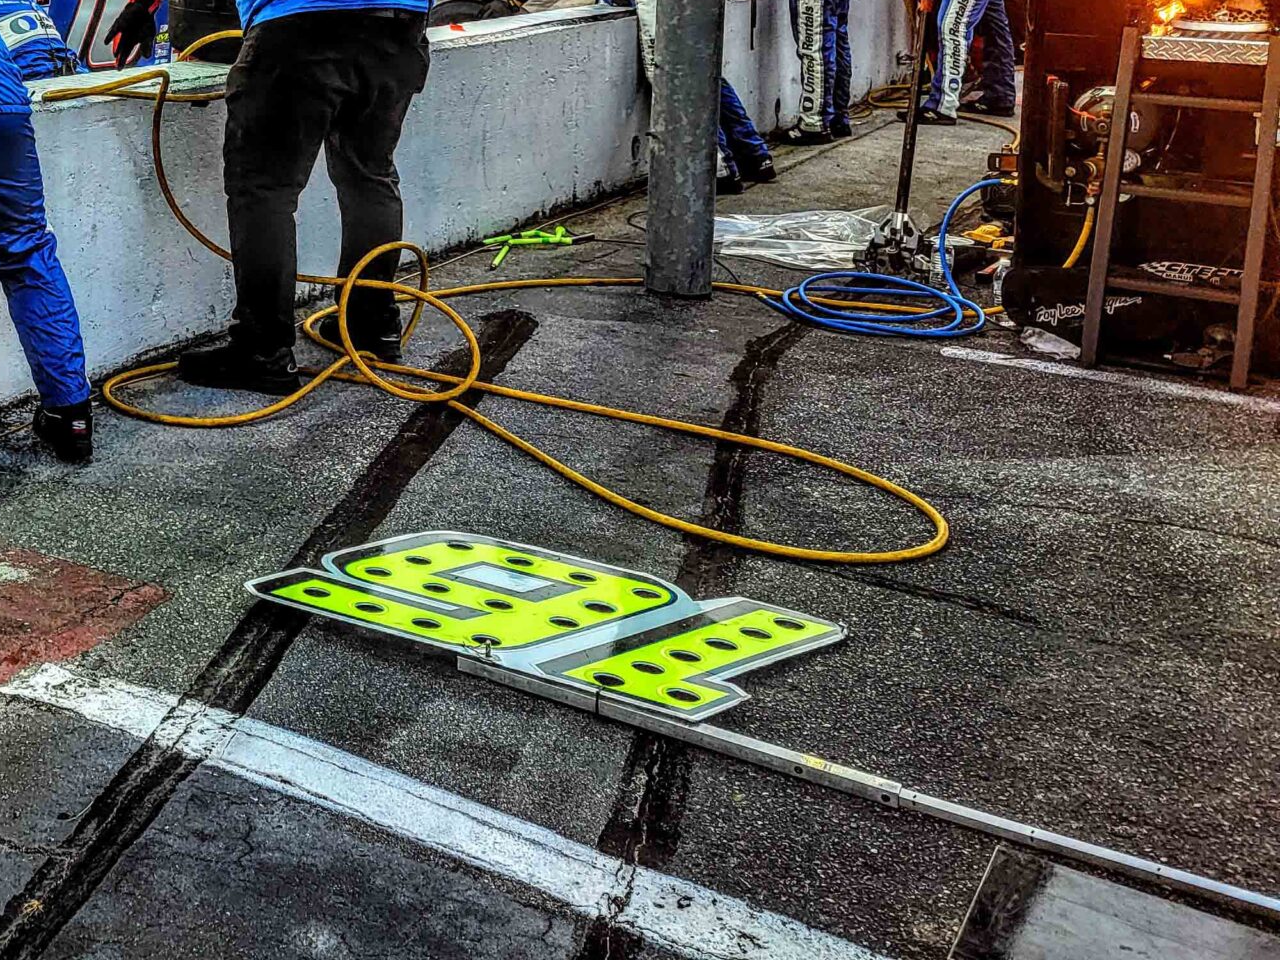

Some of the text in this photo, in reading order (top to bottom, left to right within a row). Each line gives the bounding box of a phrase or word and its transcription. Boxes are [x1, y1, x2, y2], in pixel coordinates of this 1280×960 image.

[802, 5, 815, 94] United Rentals
[949, 39, 961, 76] United
